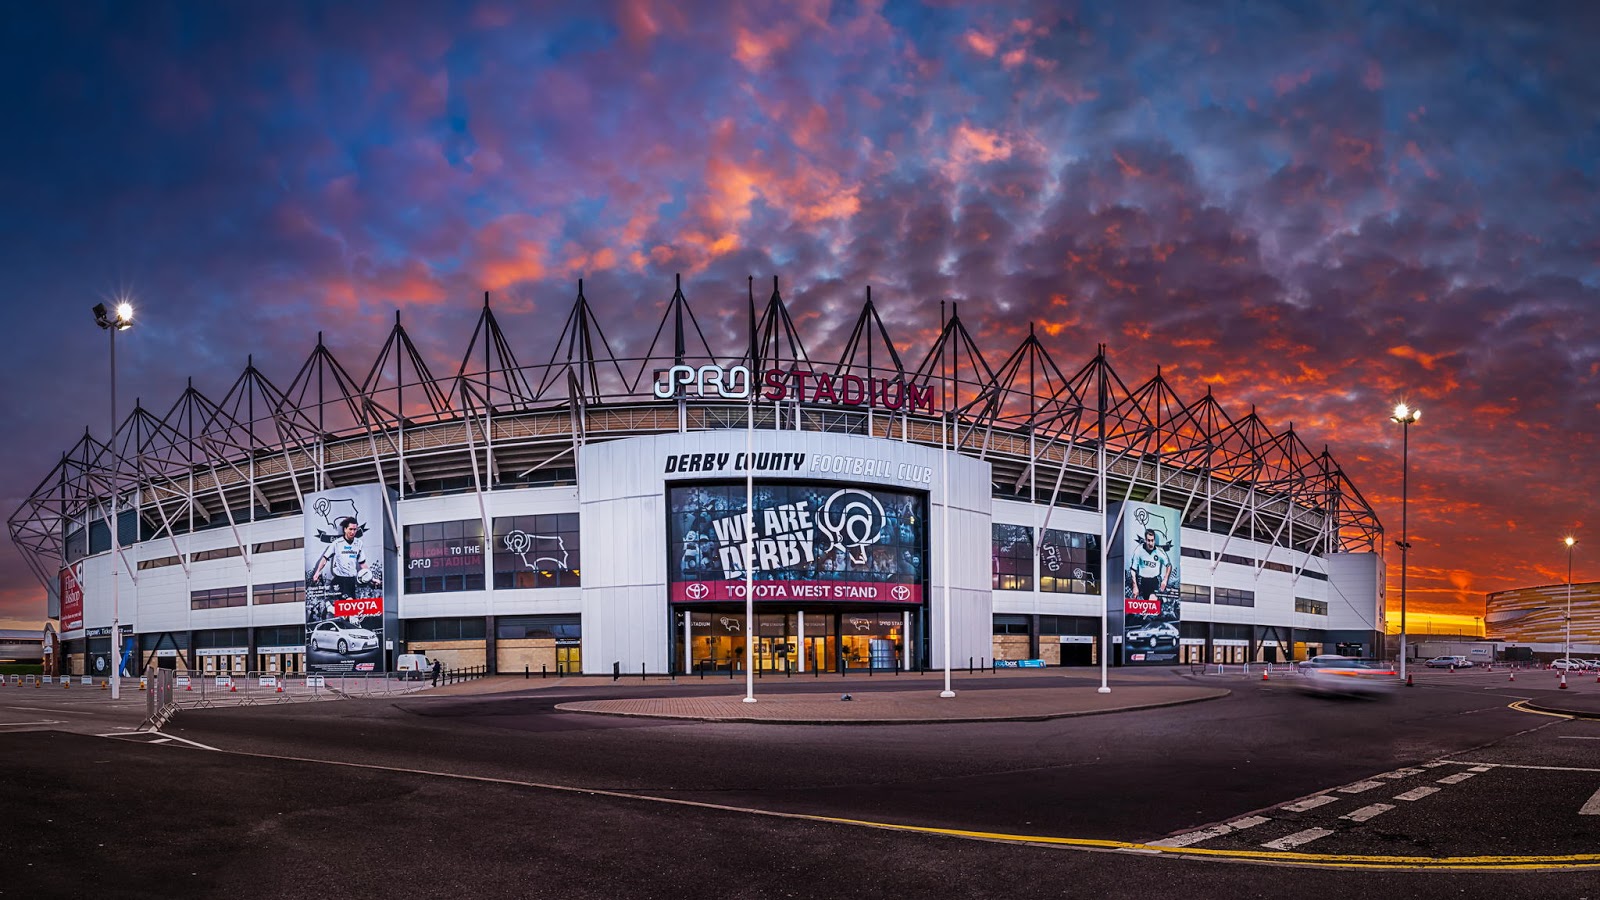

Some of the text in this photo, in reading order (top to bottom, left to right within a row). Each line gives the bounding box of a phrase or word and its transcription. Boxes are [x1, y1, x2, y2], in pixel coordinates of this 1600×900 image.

[764, 369, 935, 415] STADIUM
[665, 452, 932, 484] DERBY COUNTY FOOTBALL CLUB
[712, 500, 813, 547] WE ARE
[451, 547, 462, 555] TO
[464, 545, 480, 554] THE
[718, 528, 815, 581] DERBY
[432, 556, 481, 568] STADIUM
[726, 585, 879, 599] TOYOTA WEST STAND
[338, 601, 378, 612] TOYOTA
[1128, 602, 1157, 611] TOYOTA
